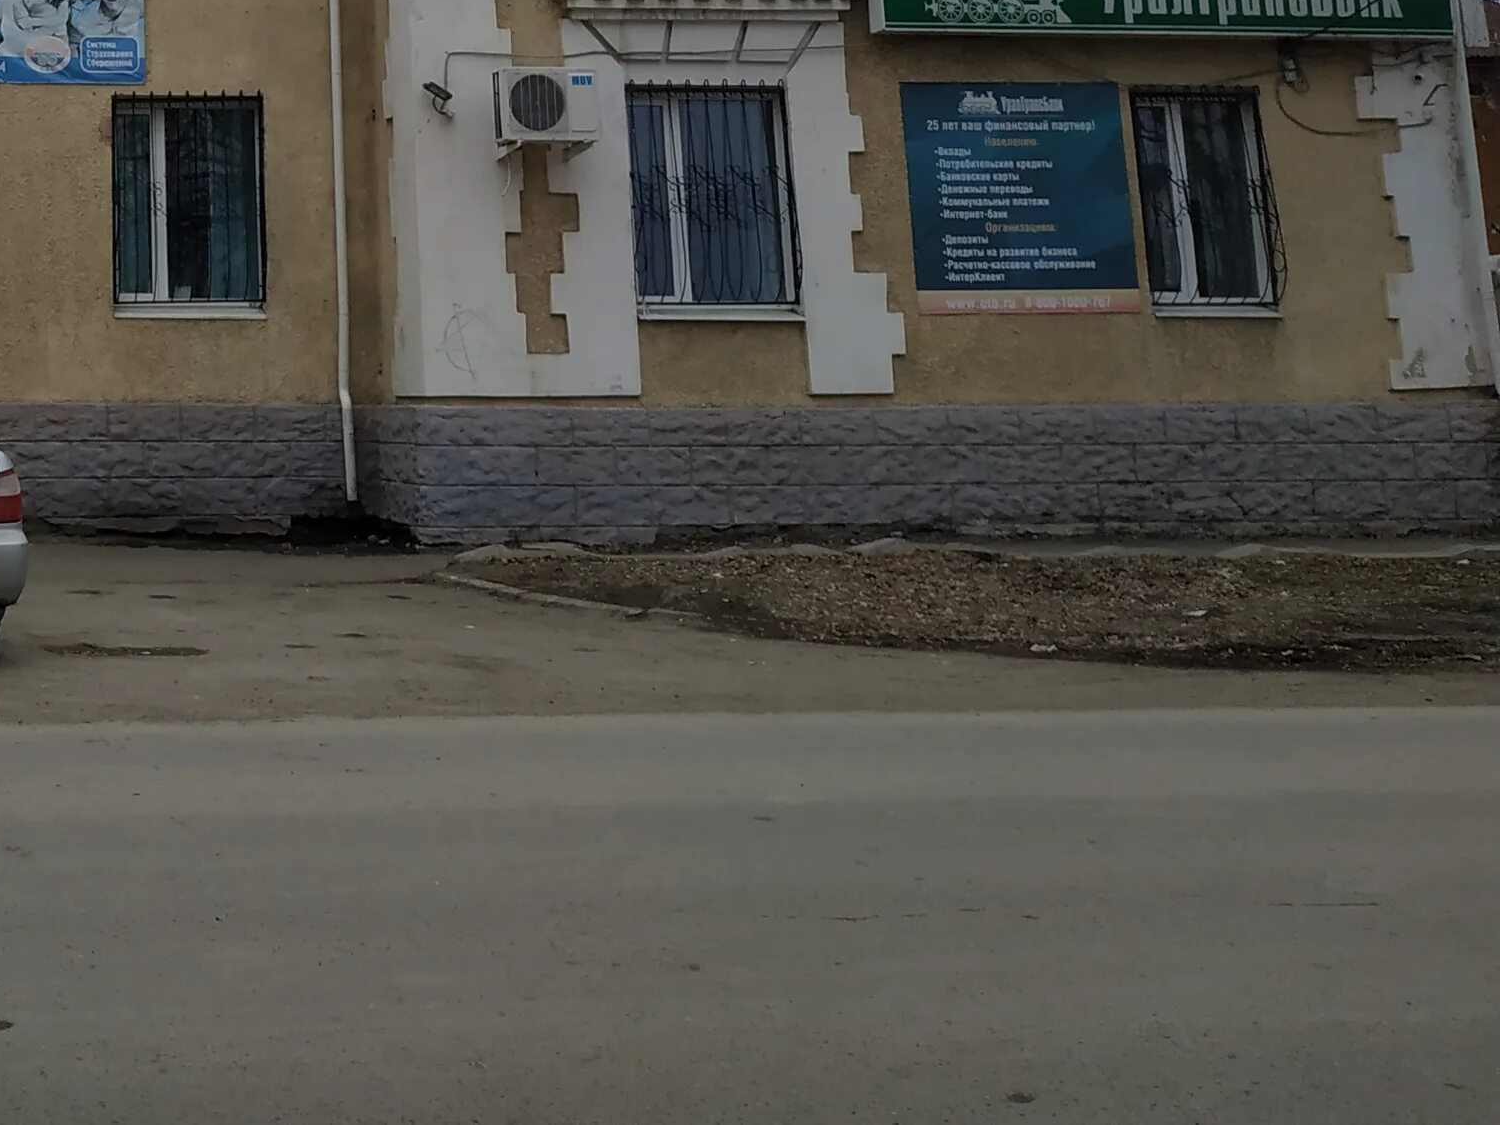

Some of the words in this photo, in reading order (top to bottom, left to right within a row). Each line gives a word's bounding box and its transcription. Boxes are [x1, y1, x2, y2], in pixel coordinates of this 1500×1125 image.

[86, 40, 117, 49] Система
[1000, 95, 1065, 115] УралТрансБанк
[926, 119, 939, 131] 25
[942, 120, 959, 131] лет
[961, 121, 983, 131] ваш
[985, 119, 1049, 133] финансовый
[1051, 120, 1096, 133] партнер!
[984, 136, 1040, 147] Населению:
[937, 146, 972, 157] Вклады
[939, 158, 1014, 170] Потребительские
[1016, 160, 1053, 169] кредиты
[940, 171, 991, 182] Банковские
[992, 173, 1020, 183] карты
[941, 184, 988, 194] Денежные
[989, 185, 1034, 196] переводы
[942, 196, 1010, 207] Коммунальные
[1012, 197, 1050, 206] платежи
[943, 208, 1008, 220] Интернет-банк
[944, 234, 989, 245] Депозиты
[946, 247, 985, 258] Кредиты
[987, 249, 998, 257] на
[999, 248, 1040, 258] развитие
[1041, 246, 1078, 257] бизнеса
[947, 260, 1031, 271] Расчетно-кассовое
[1033, 259, 1097, 271] обслуживание
